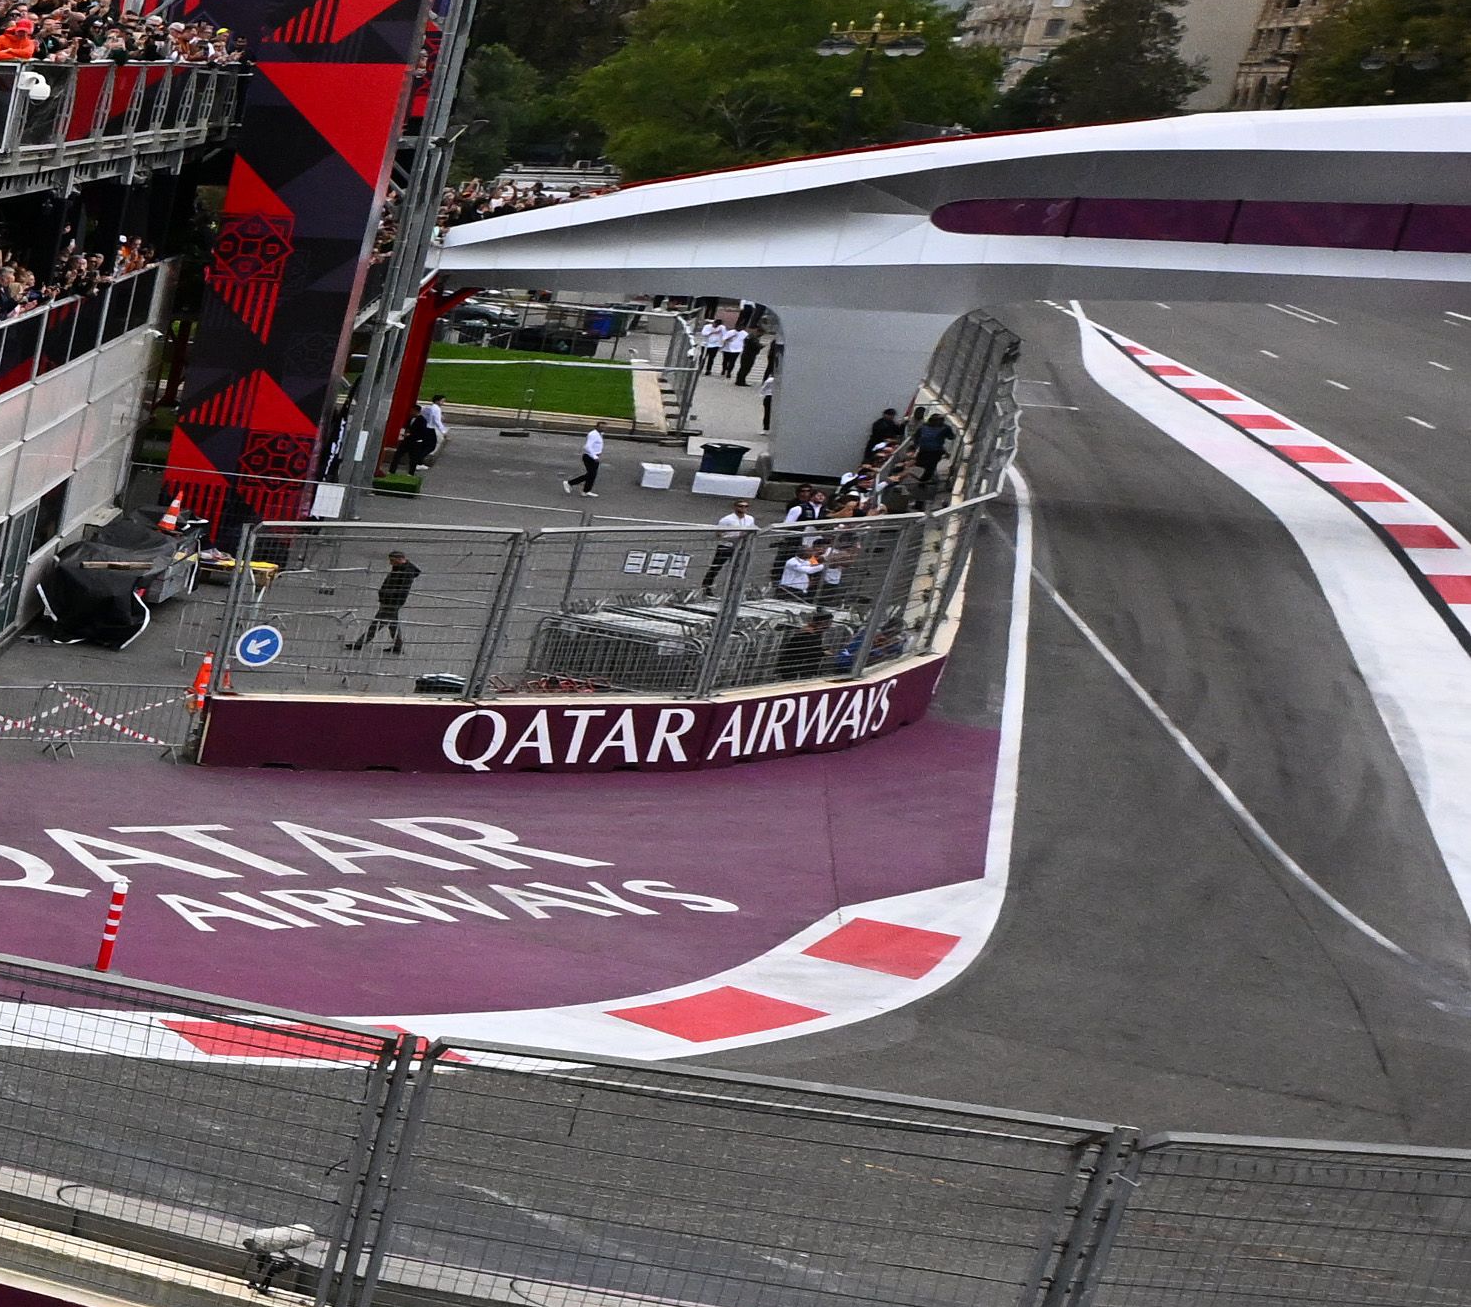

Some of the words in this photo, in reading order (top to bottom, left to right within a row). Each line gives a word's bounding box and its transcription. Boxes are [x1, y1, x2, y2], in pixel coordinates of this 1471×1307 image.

[441, 708, 695, 771] QATAR
[706, 677, 898, 761] AIRWAYS
[157, 879, 739, 933] AIRWAYS
